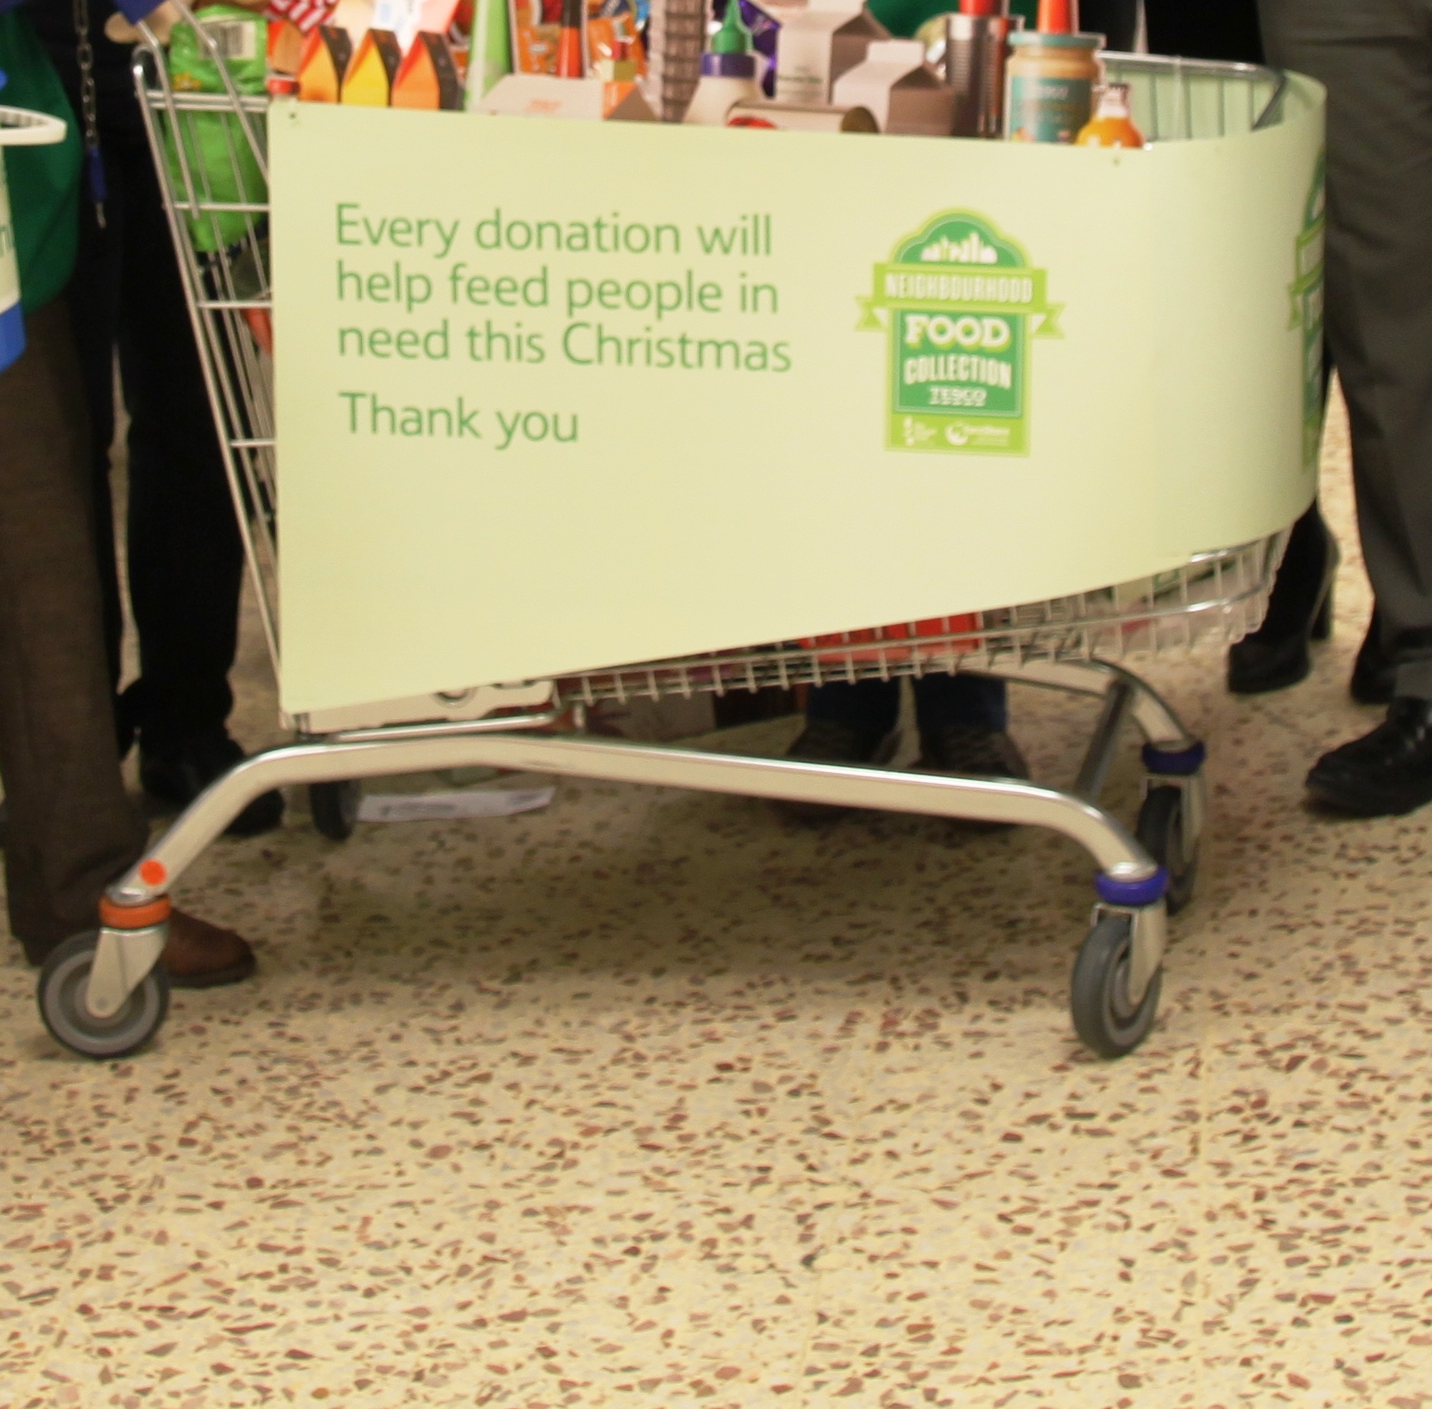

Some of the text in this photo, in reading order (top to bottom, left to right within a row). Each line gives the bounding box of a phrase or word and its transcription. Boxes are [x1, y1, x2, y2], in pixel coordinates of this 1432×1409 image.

[336, 202, 772, 259] Every donation will
[337, 259, 779, 321] help feed people in
[884, 273, 1034, 305] NEIGHBOURHOOD
[338, 318, 793, 374] need this Christmas
[904, 312, 1011, 348] FOOD
[903, 353, 1012, 390] COLLECTION
[929, 386, 988, 407] TESCO
[338, 391, 579, 452] Thank you
